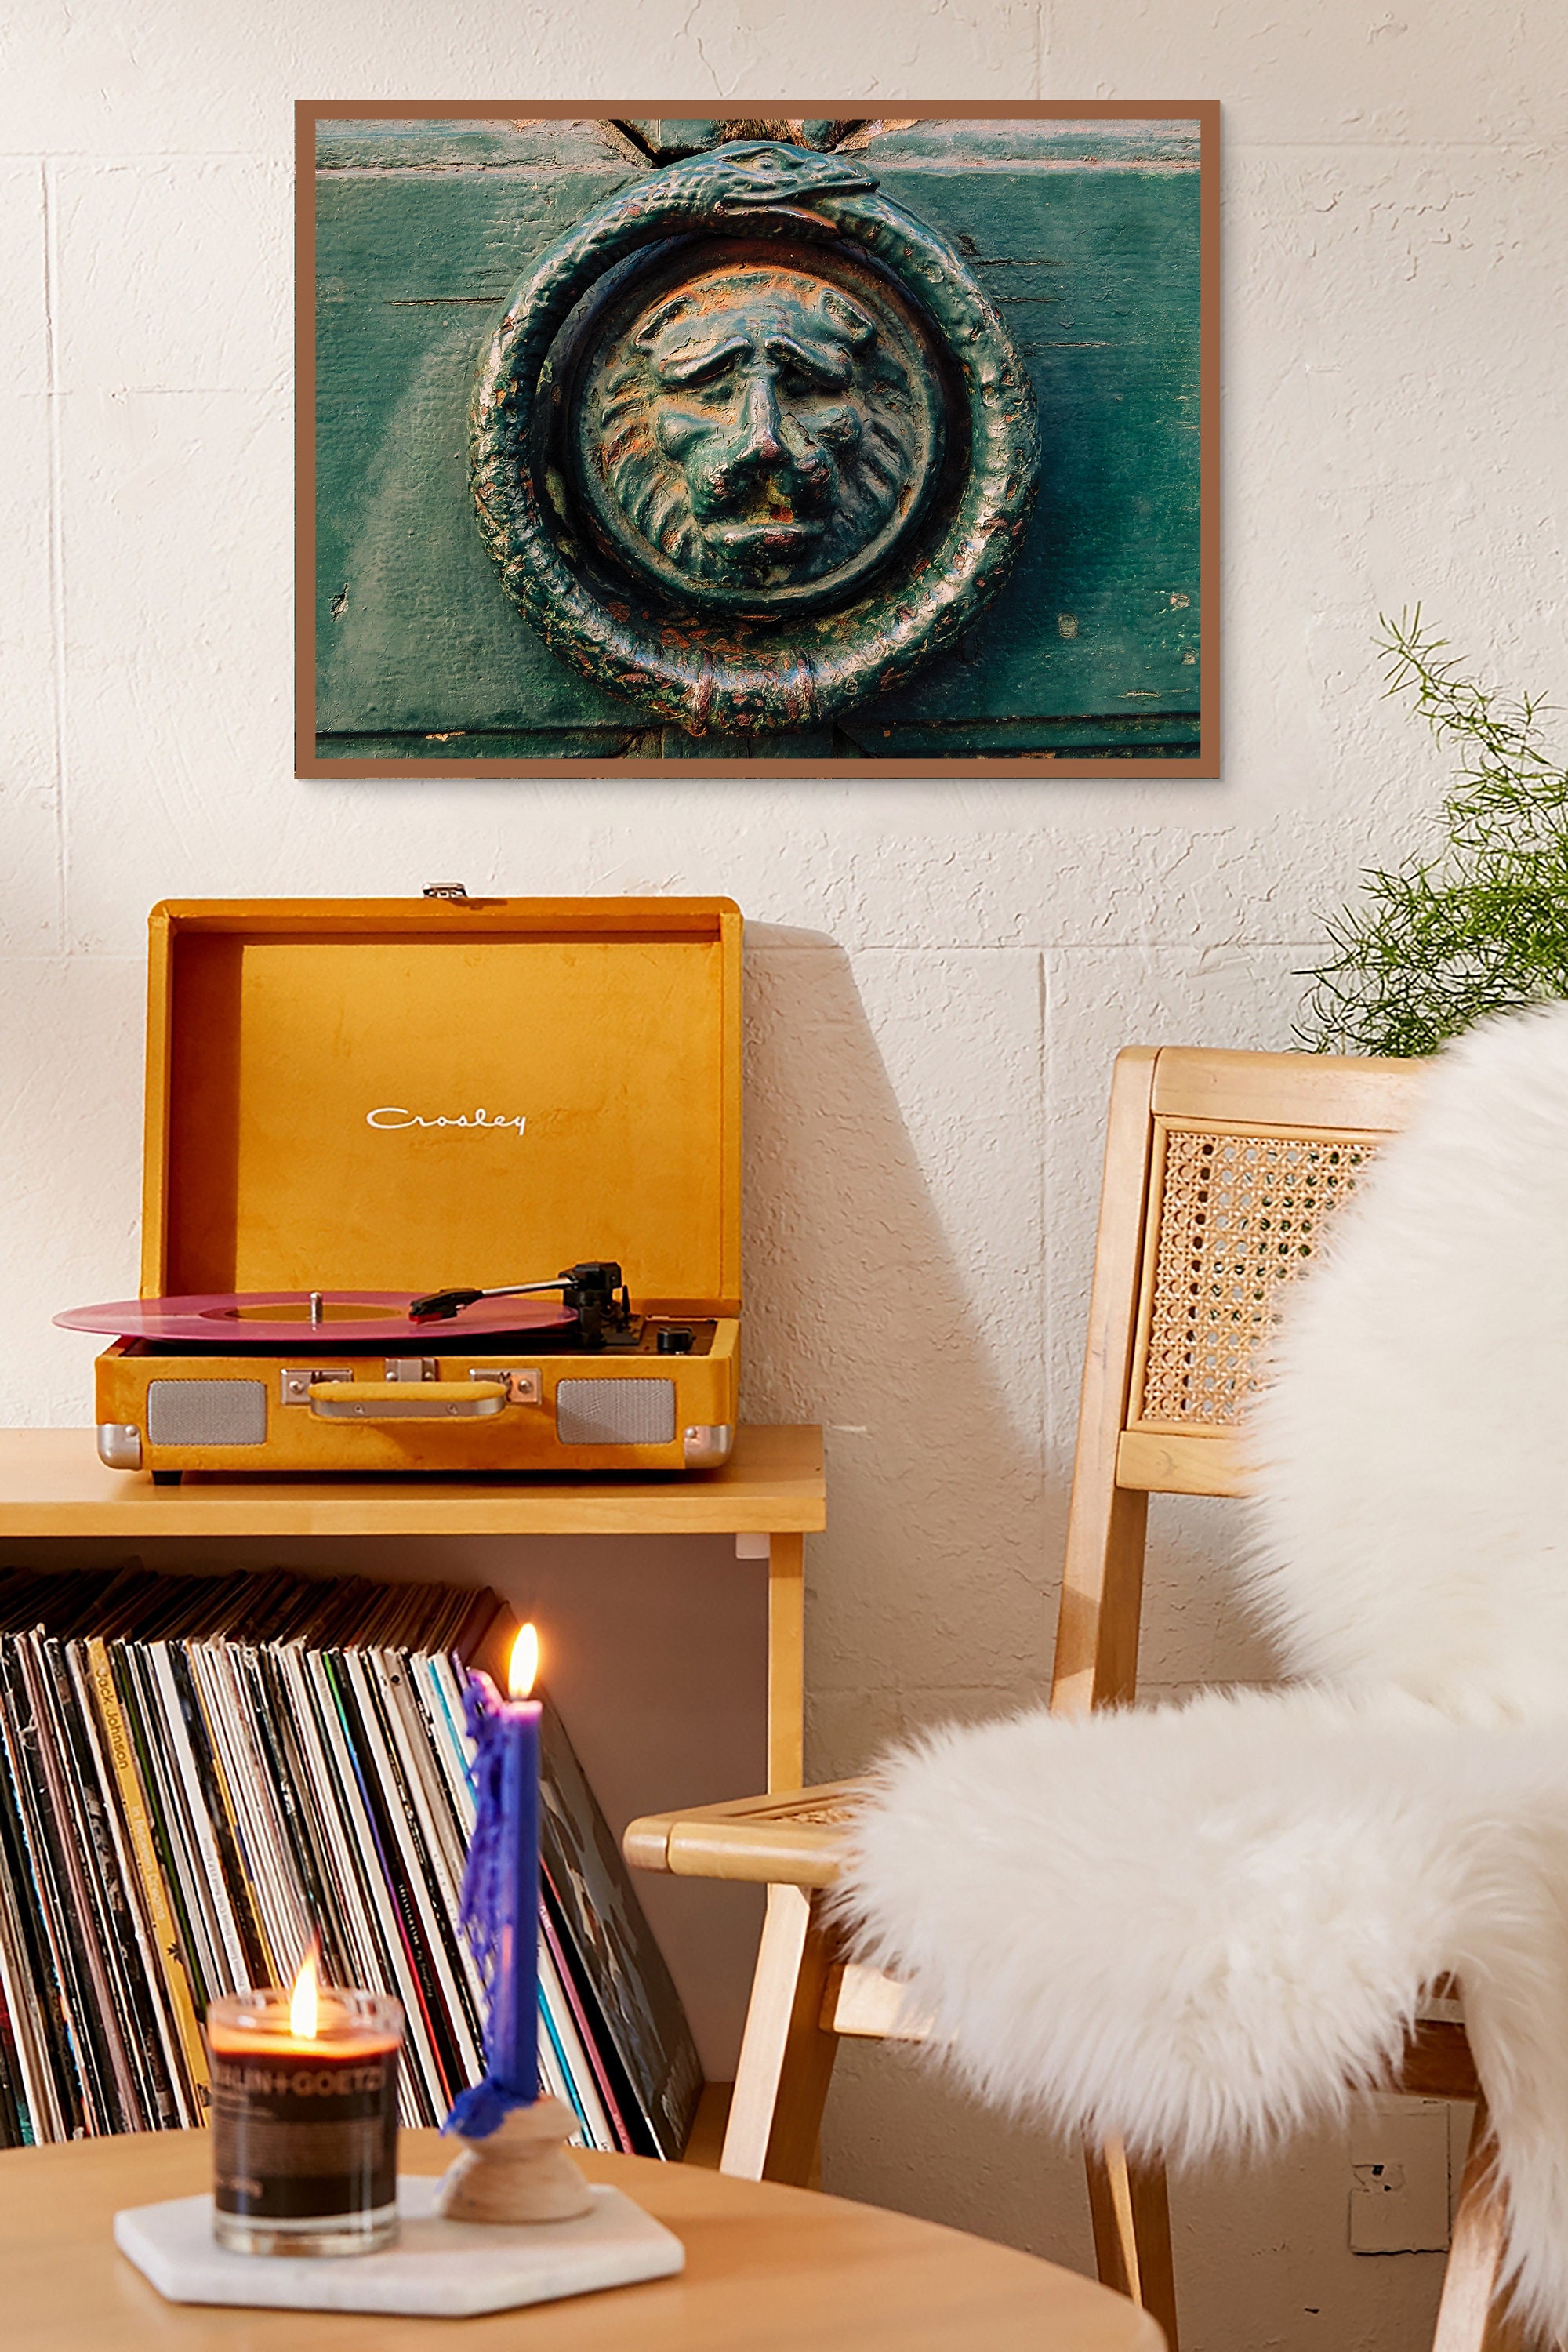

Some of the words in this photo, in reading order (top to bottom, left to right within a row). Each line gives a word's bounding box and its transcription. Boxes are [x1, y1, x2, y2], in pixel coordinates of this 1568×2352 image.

[366, 1107, 526, 1135] Crosley
[96, 1670, 114, 1705] Jack
[106, 1709, 129, 1769] Johnson
